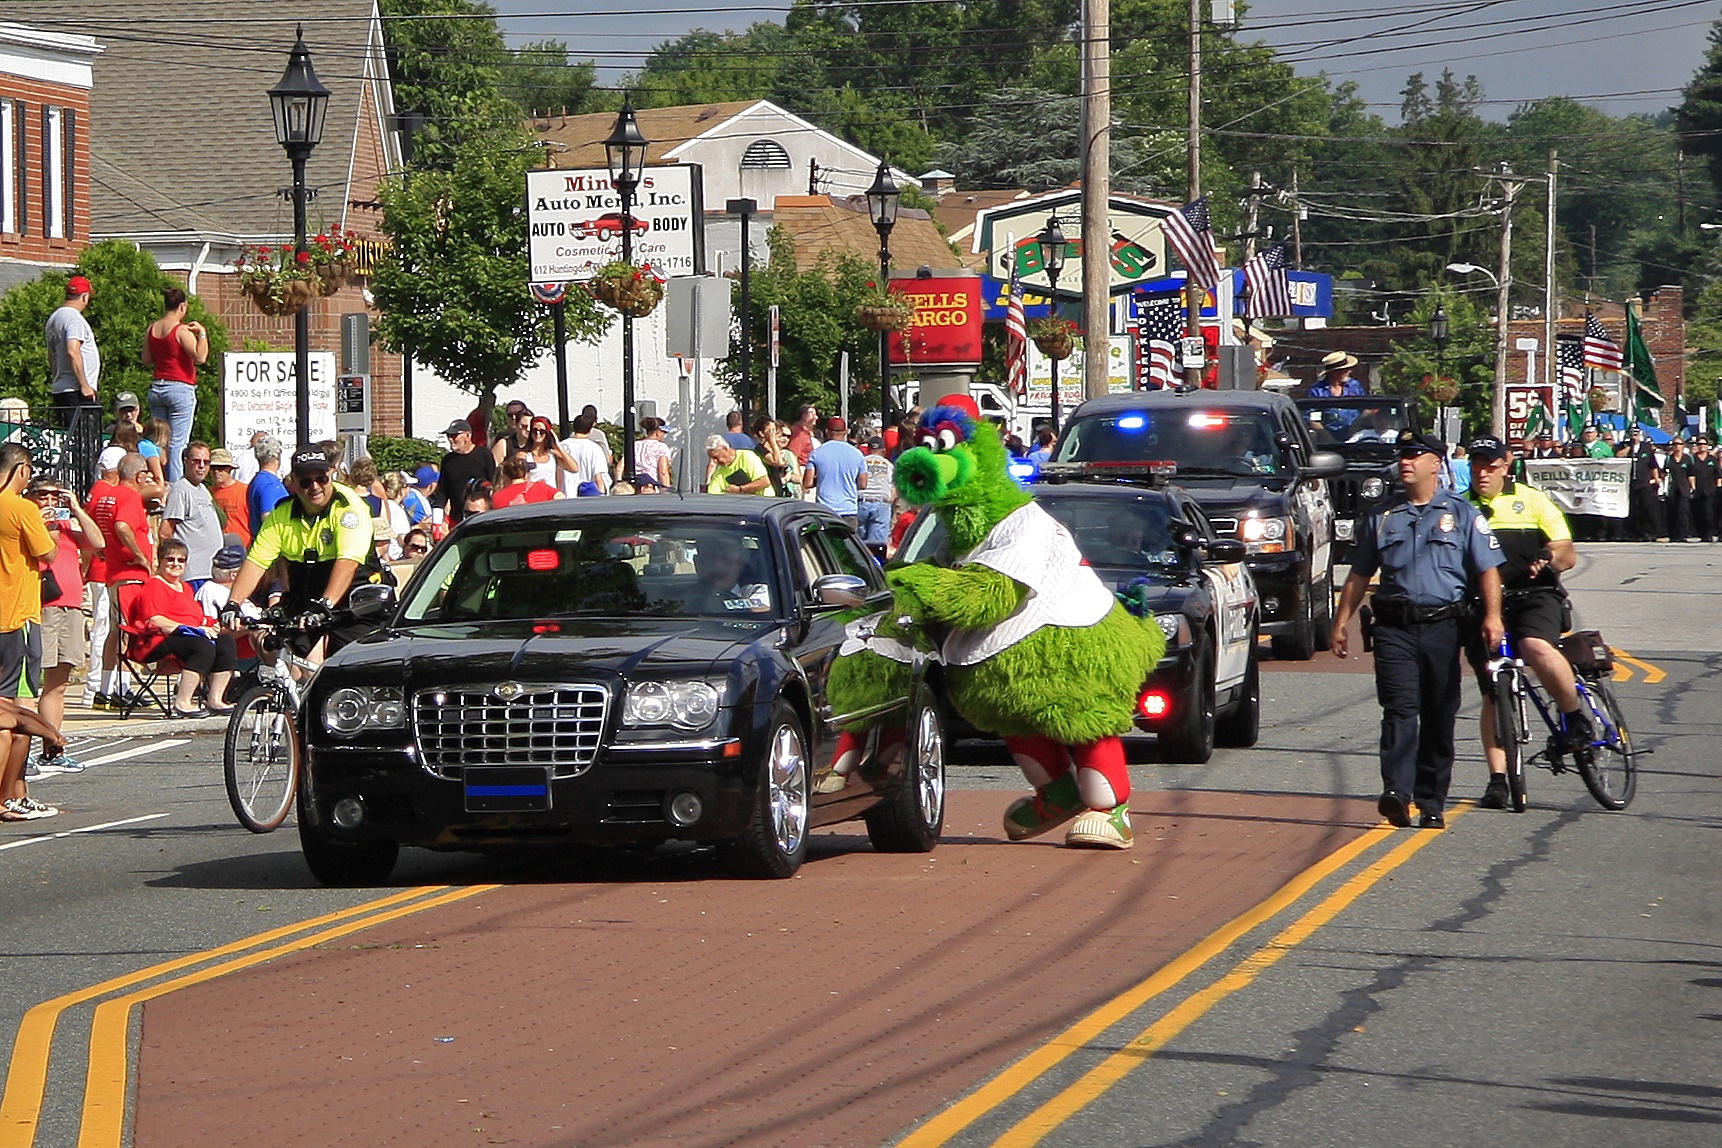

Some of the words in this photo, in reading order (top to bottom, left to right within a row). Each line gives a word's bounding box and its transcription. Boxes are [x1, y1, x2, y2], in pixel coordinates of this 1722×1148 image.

[535, 197, 581, 211] Auto
[649, 192, 686, 206] Inc.
[532, 223, 565, 237] AUTO
[653, 217, 688, 232] BODY
[556, 245, 610, 257] Cosmetic
[615, 244, 635, 255] Cr
[640, 243, 666, 253] Care
[549, 263, 591, 275] Huntingd
[910, 310, 968, 327] ARGO
[236, 361, 270, 382] FOR
[276, 361, 320, 382] SAE
[1533, 470, 1570, 481] REILLY
